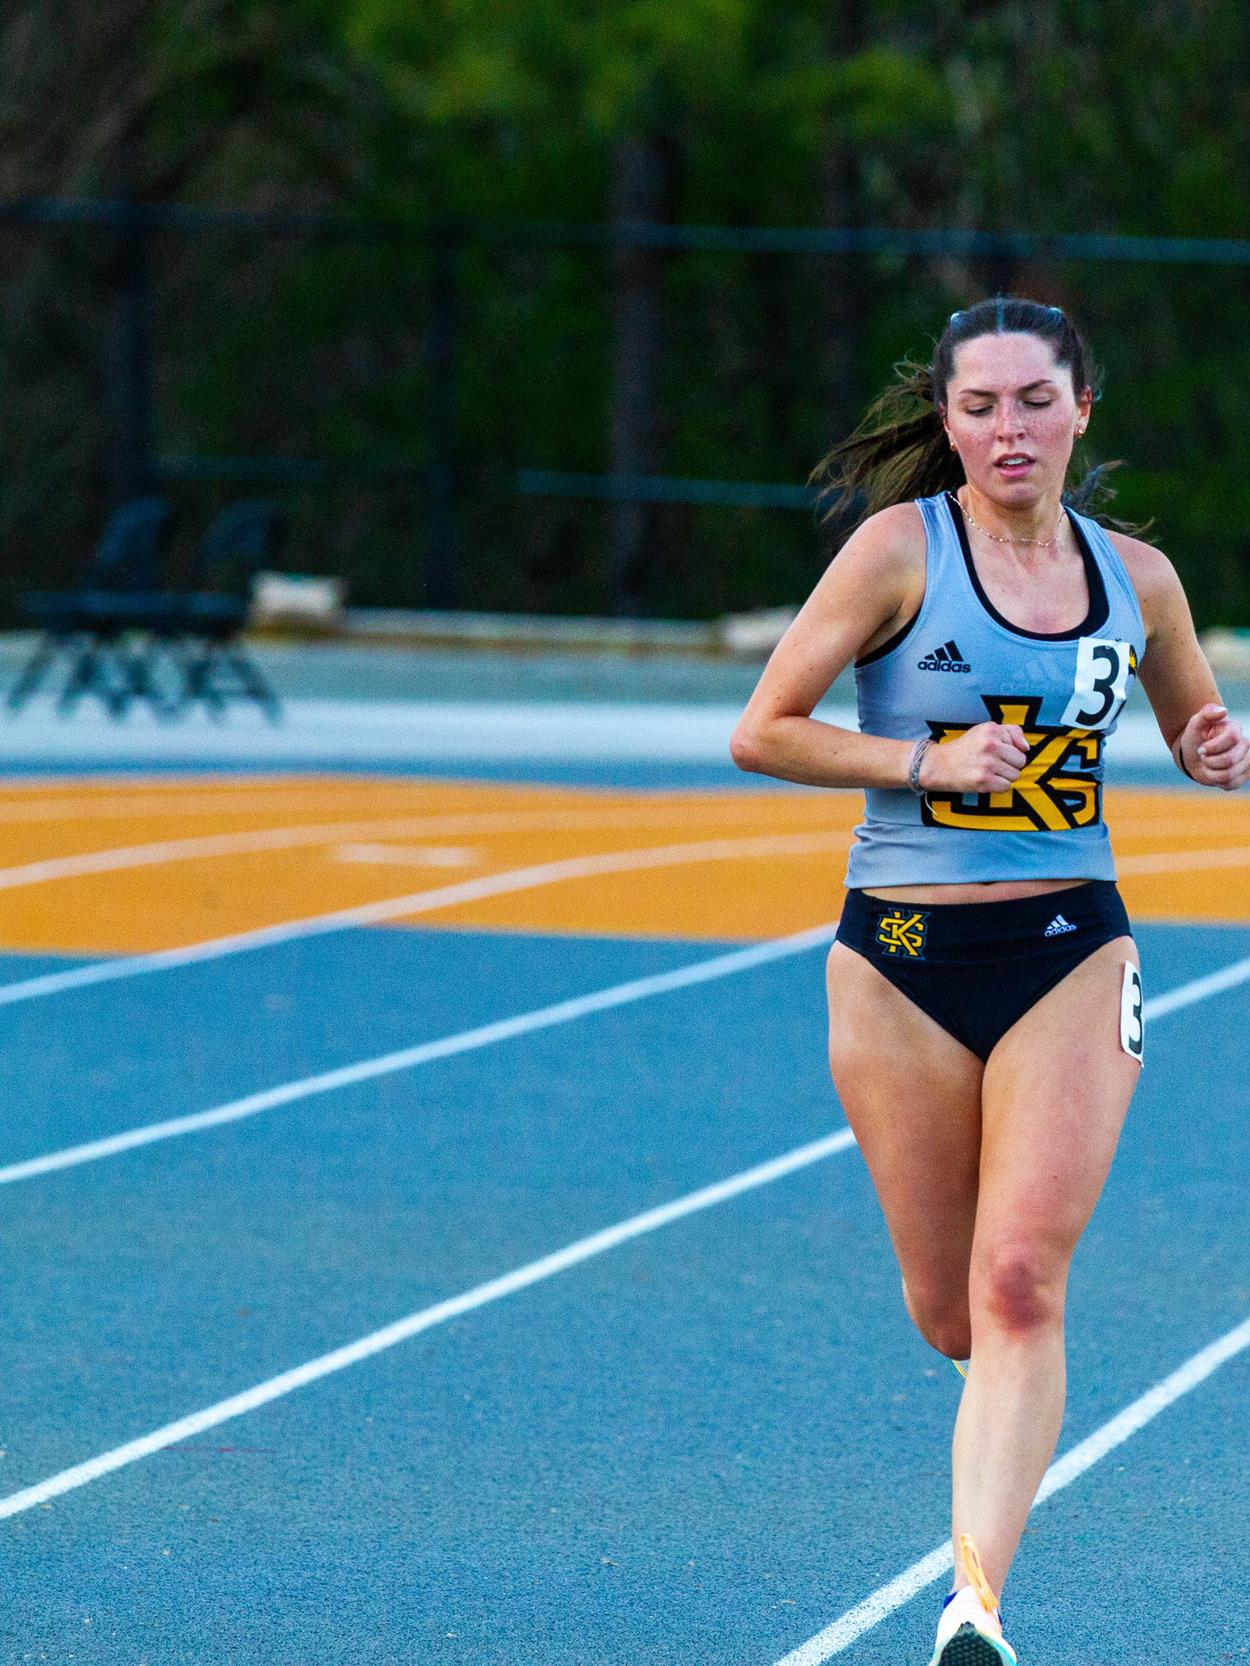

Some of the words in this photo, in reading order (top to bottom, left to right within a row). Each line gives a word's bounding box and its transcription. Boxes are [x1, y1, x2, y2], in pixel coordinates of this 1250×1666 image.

[917, 659, 971, 673] adidas
[1075, 645, 1120, 726] 3
[1128, 972, 1142, 1055] 3
